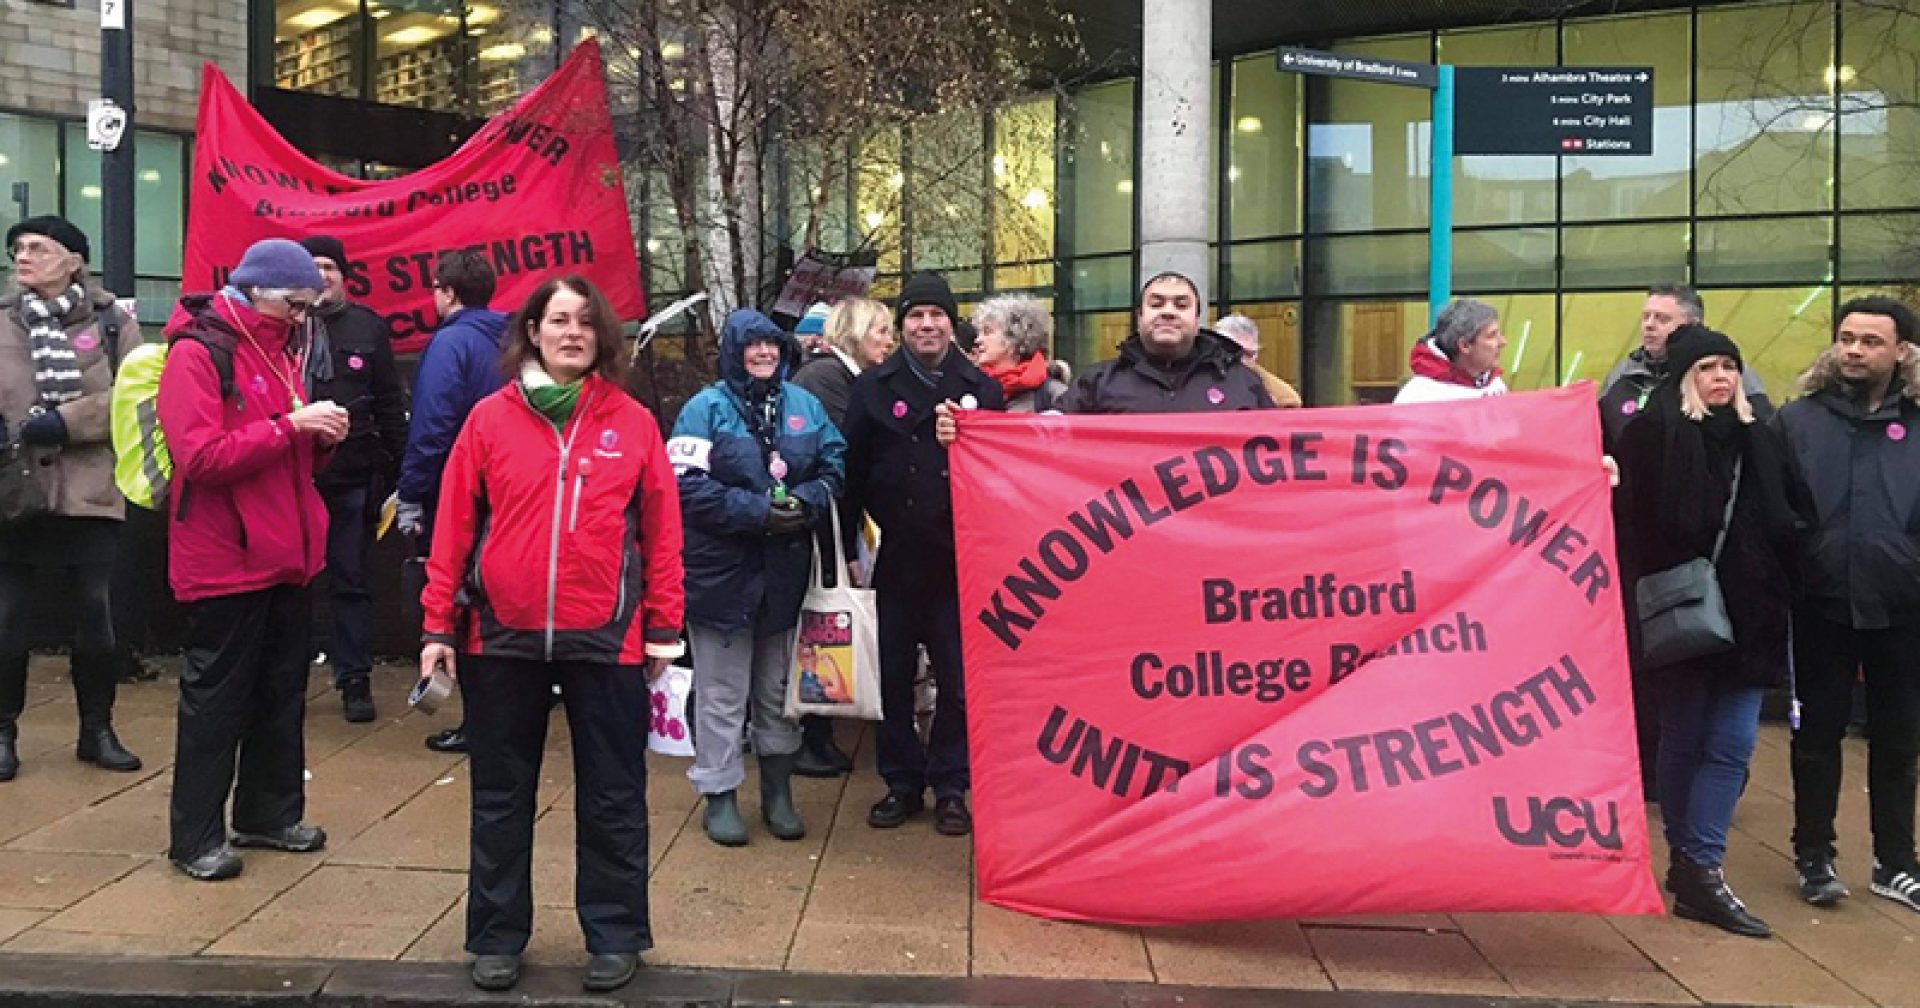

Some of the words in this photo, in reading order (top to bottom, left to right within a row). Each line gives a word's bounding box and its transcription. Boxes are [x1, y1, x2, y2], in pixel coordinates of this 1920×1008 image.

[1296, 54, 1342, 72] University
[1344, 60, 1355, 71] of
[1355, 60, 1395, 75] Bradford
[1533, 72, 1587, 82] Alhambra
[1588, 72, 1632, 82] Theatre
[1581, 93, 1604, 106] City
[1607, 93, 1632, 104] Park
[1583, 114, 1606, 128] City
[1608, 115, 1632, 126] Hall
[1586, 138, 1632, 149] Stations
[386, 230, 594, 293] STNGTH
[978, 432, 1327, 651] KNOWLEDGE
[1351, 433, 1408, 490] IS
[1428, 456, 1612, 605] POWER
[1203, 571, 1417, 624] Bradford
[1131, 651, 1311, 702] College
[1215, 743, 1275, 799] IS
[1300, 654, 1598, 798] STRENGTH
